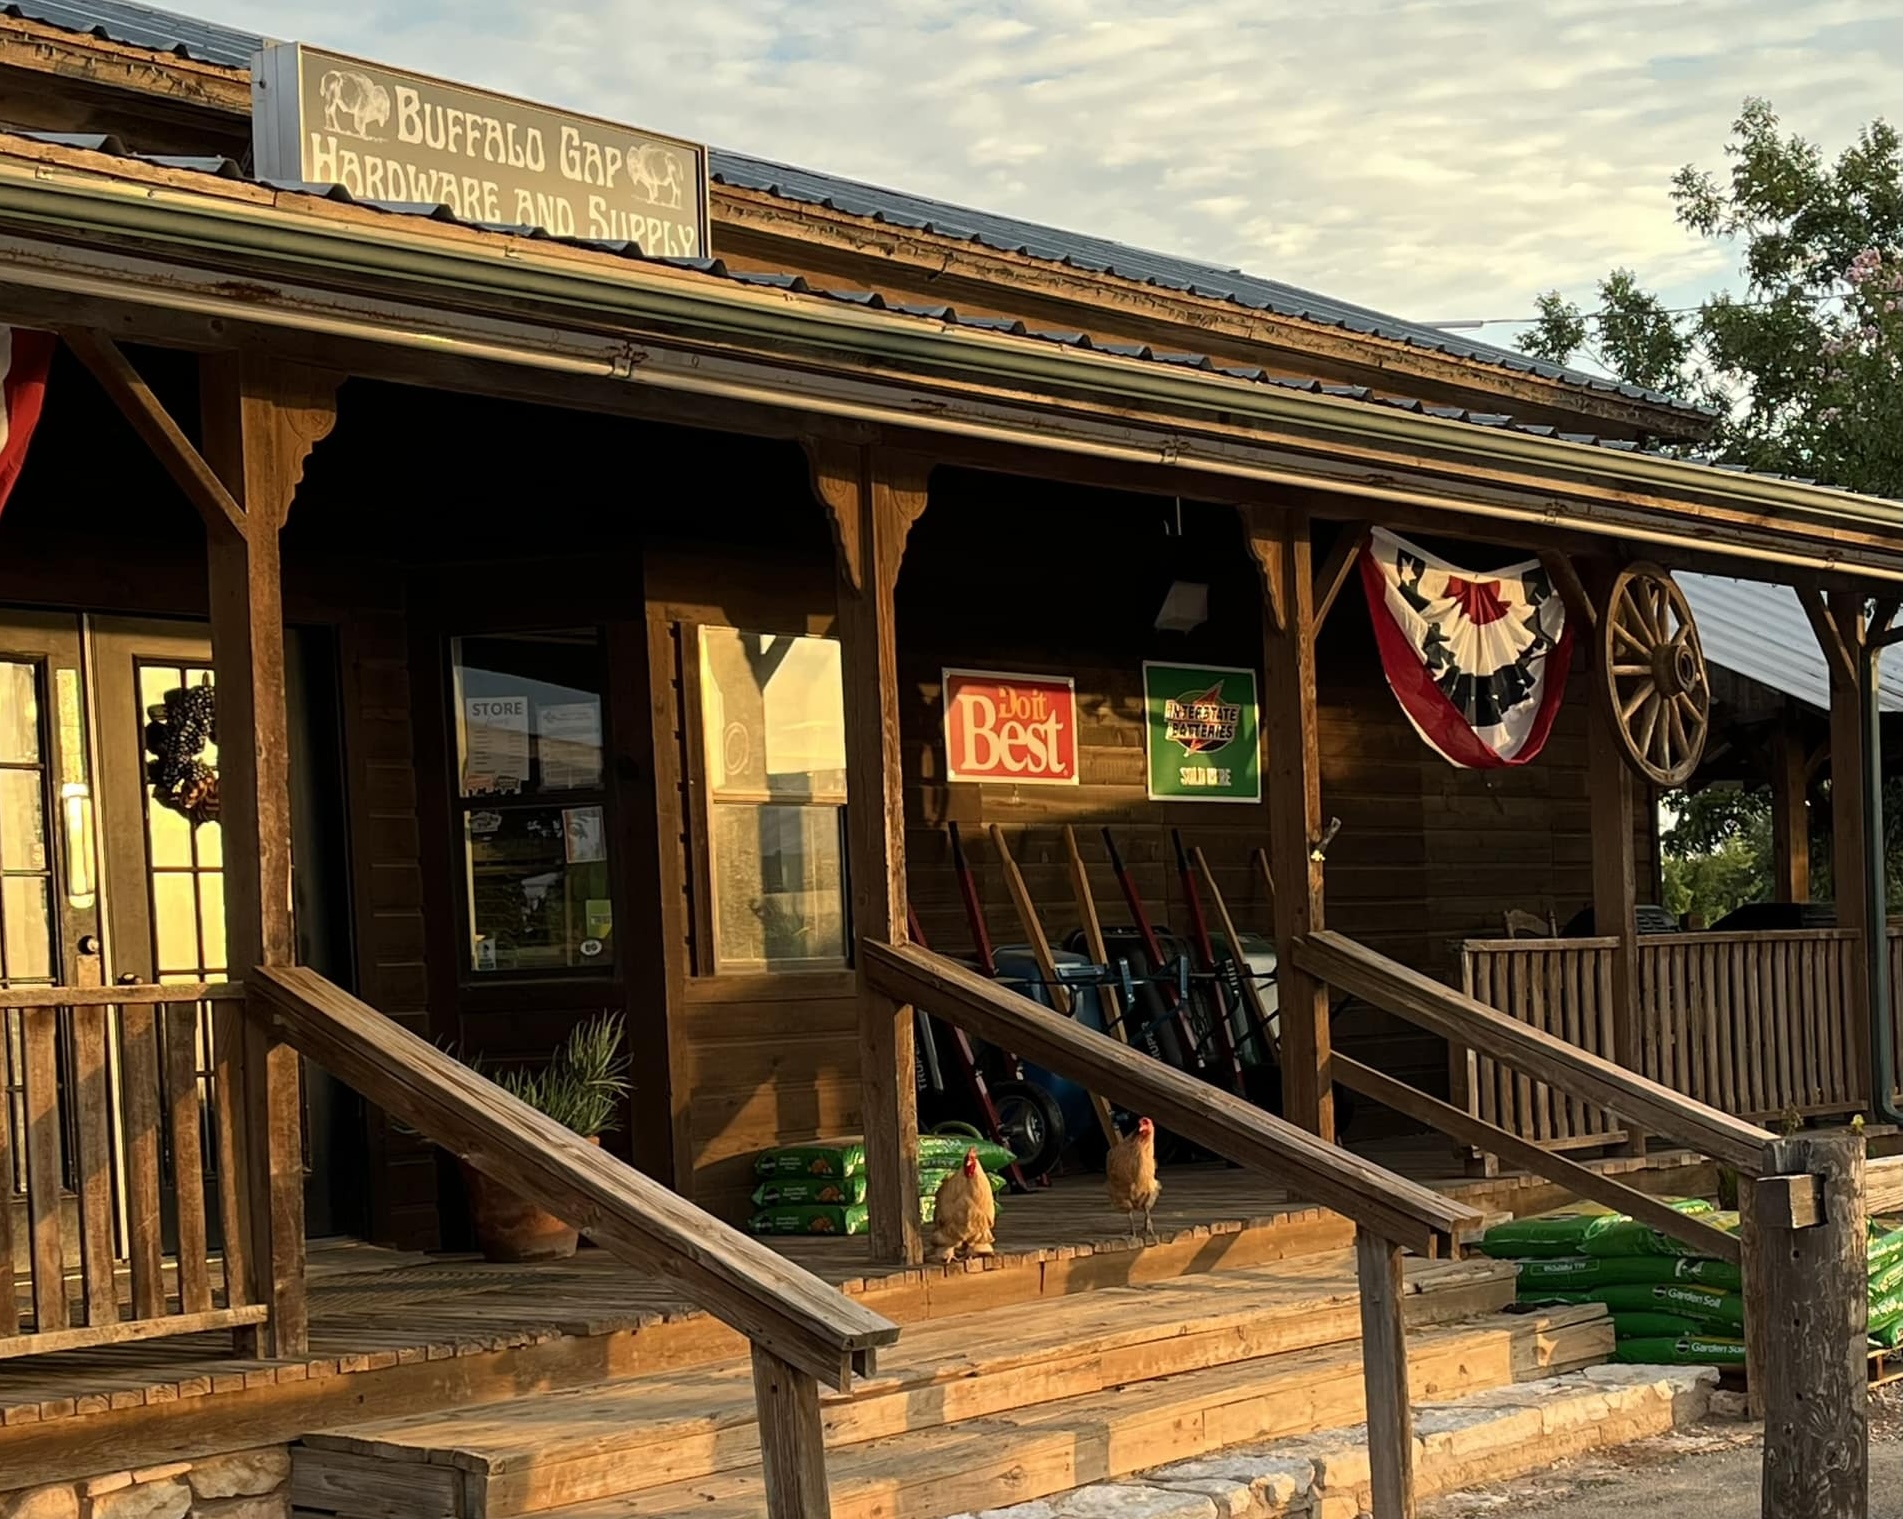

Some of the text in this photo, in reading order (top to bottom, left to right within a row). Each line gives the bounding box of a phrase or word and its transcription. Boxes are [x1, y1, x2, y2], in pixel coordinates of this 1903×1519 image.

[394, 85, 546, 172] BUFFALO
[310, 132, 696, 257] HARDWARE AND SUPPLY
[471, 701, 523, 716] STORE
[998, 686, 1048, 721] Do it
[1167, 701, 1238, 722] INTERSTATE
[956, 693, 1066, 774] Best
[1171, 722, 1233, 739] BATTERIES
[1179, 767, 1205, 785] SOLD
[1140, 1020, 1162, 1061] RUPER
[915, 1043, 929, 1093] TRUP
[1667, 1287, 1722, 1308] Garden Soil
[1691, 1342, 1727, 1354] Garden
